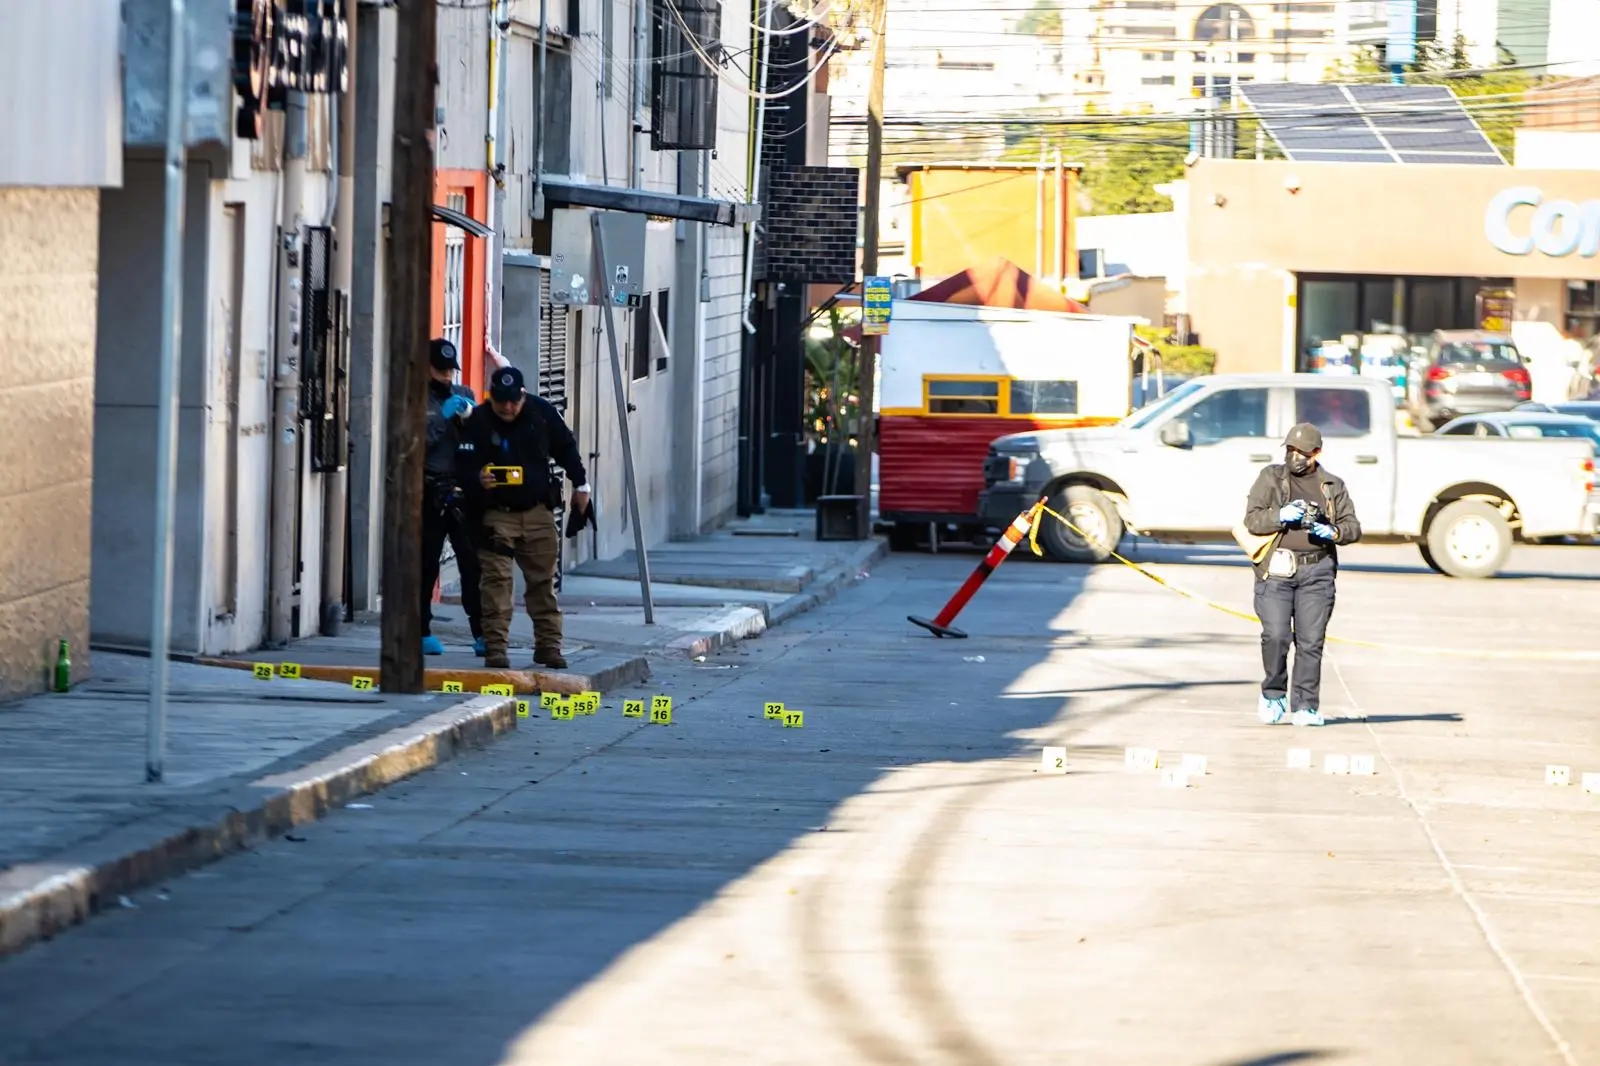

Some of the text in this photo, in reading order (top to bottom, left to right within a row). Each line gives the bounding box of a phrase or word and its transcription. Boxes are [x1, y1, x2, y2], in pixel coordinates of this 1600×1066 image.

[282, 665, 296, 675] 34
[354, 679, 369, 689] 27
[625, 703, 640, 713] 24
[654, 699, 669, 708] 37
[555, 705, 569, 715] 15
[767, 704, 781, 714] 32
[653, 710, 668, 720] 16
[786, 714, 800, 724] 17
[1055, 757, 1063, 768] 2
